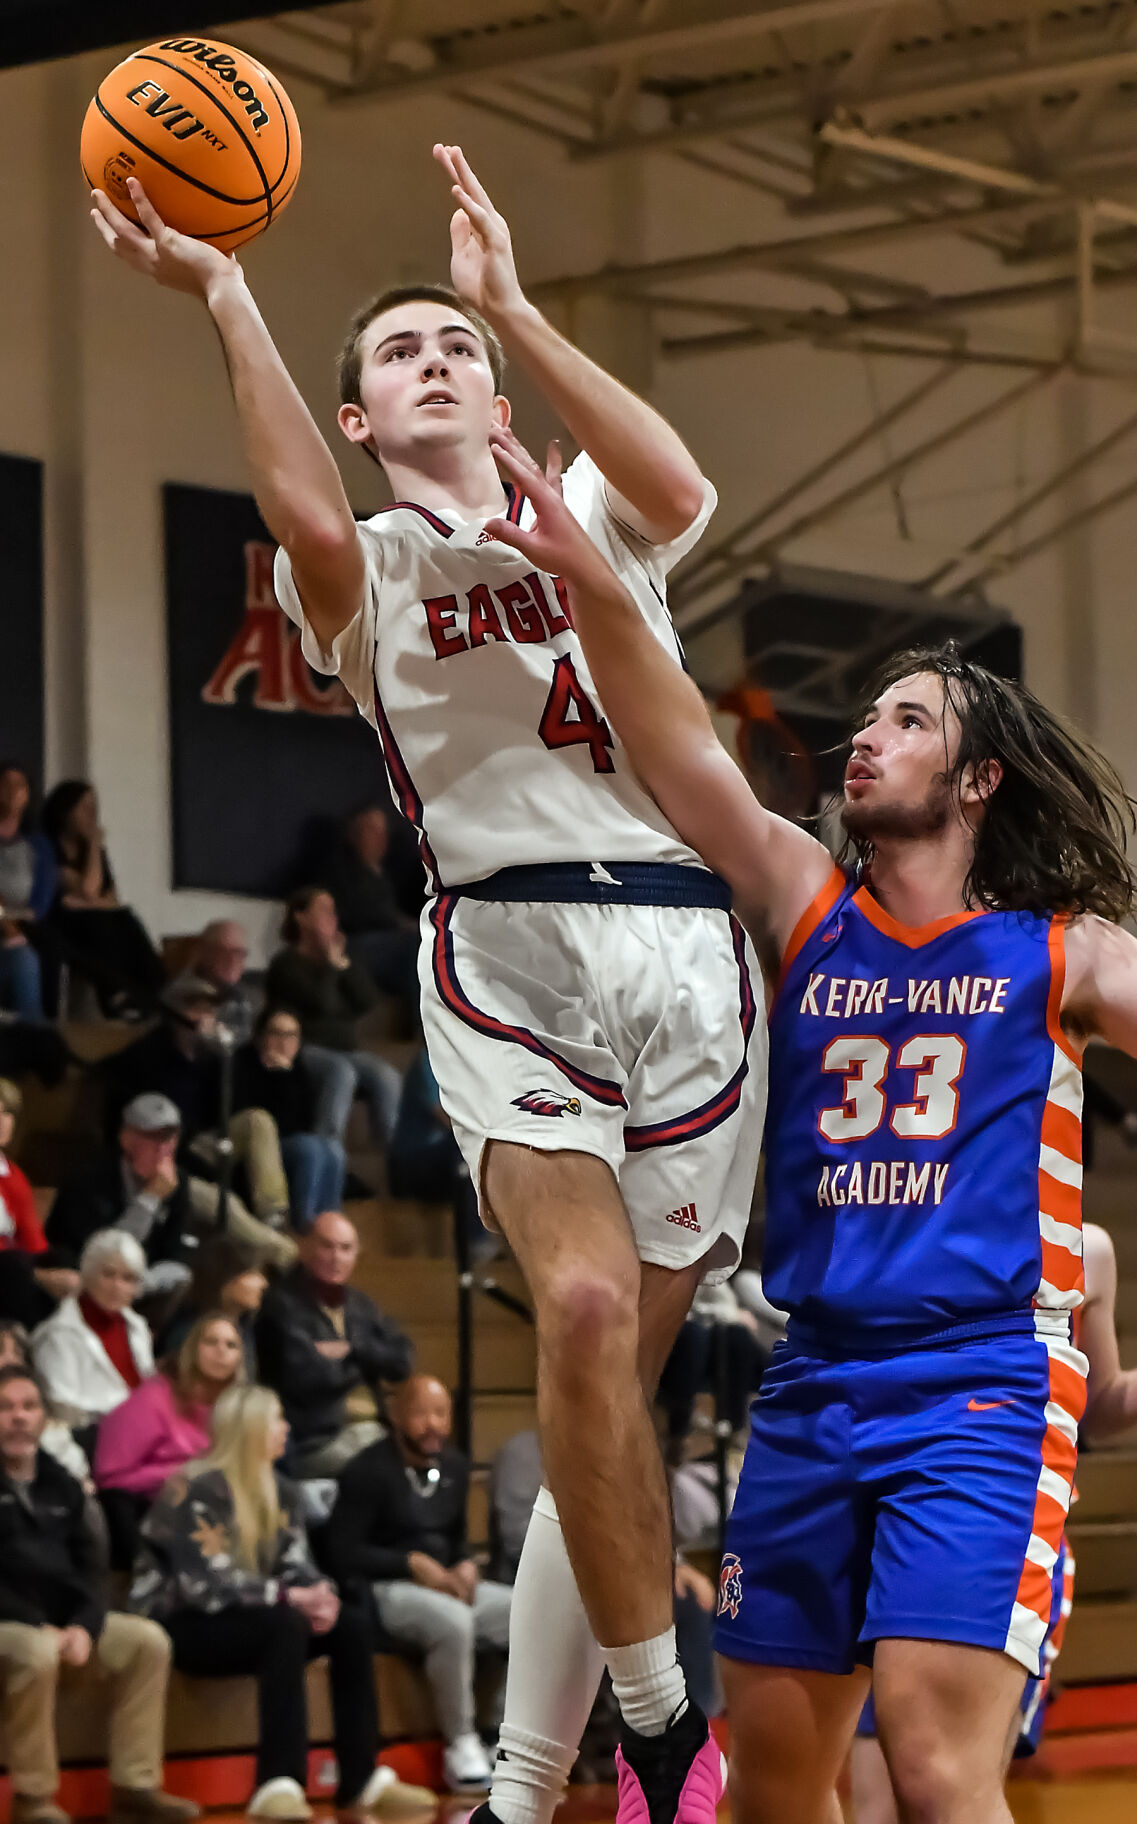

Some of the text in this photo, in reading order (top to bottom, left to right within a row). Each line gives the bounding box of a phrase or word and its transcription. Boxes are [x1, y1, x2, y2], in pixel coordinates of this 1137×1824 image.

[126, 80, 228, 151] EVO NXT
[538, 652, 616, 774] 4
[800, 973, 1011, 1018] KERR-VANCE
[817, 1033, 967, 1144] 33
[817, 1161, 950, 1207] ACADEMY
[665, 1212, 702, 1234] adidas
